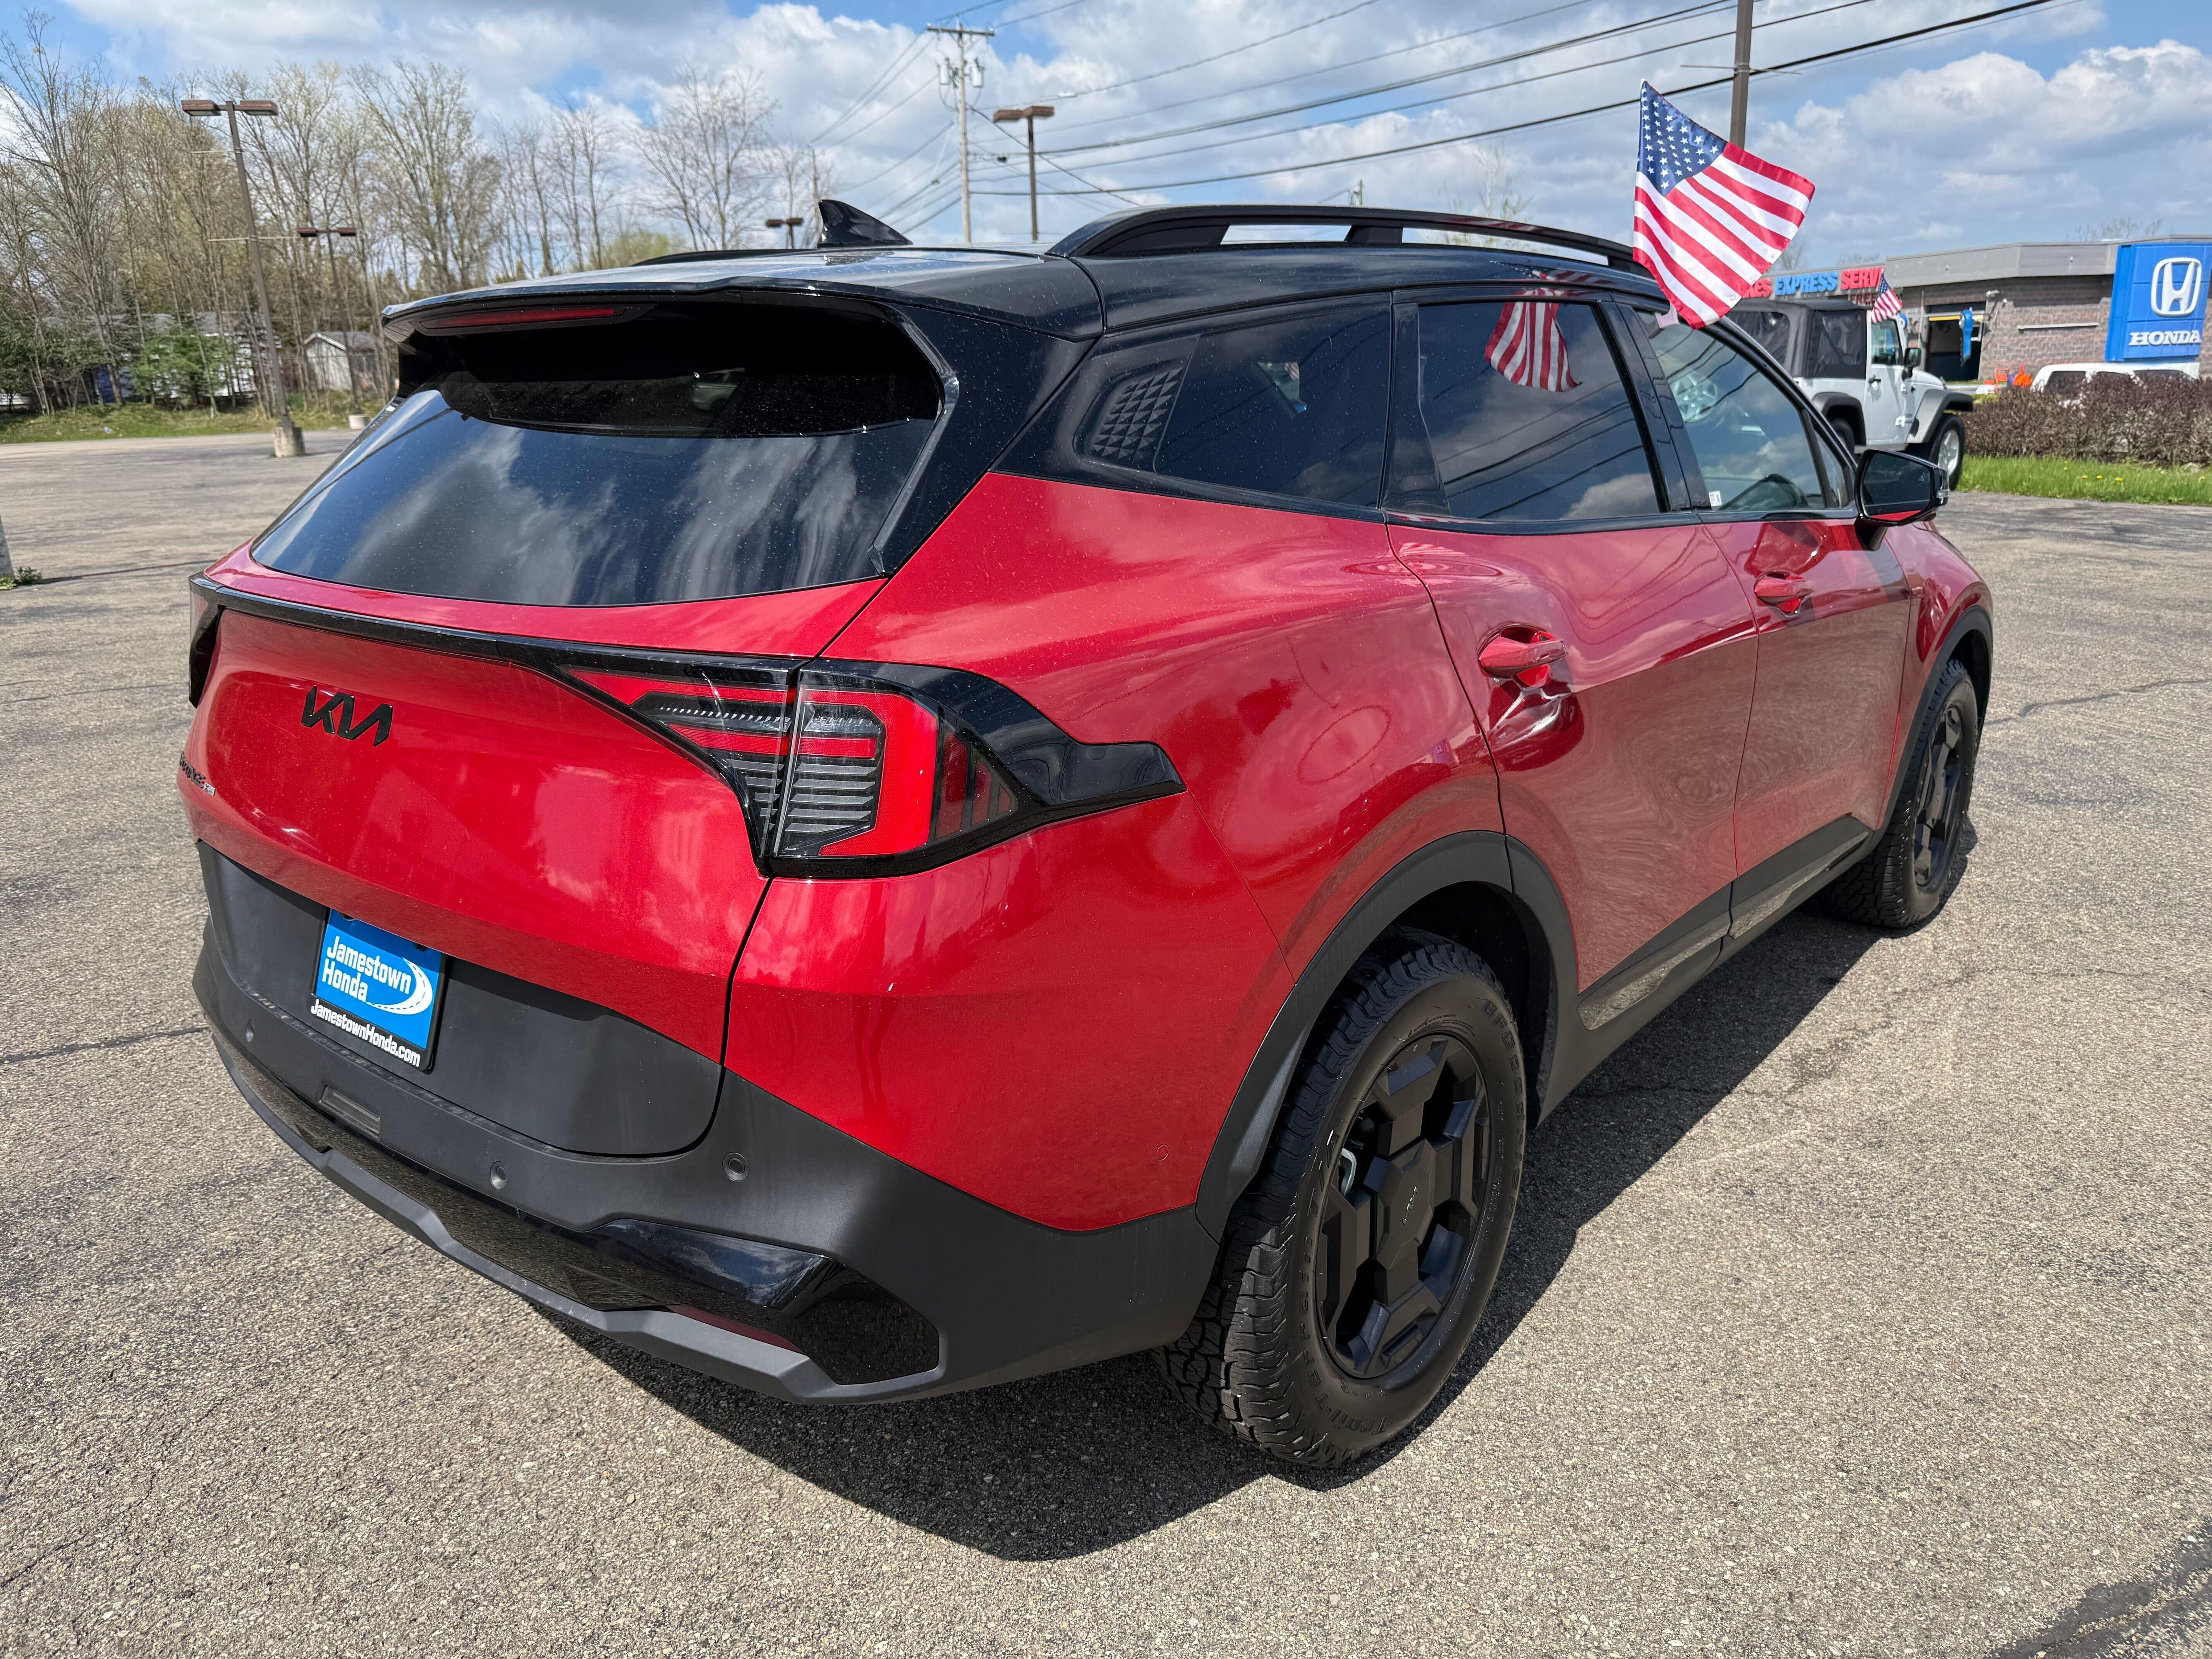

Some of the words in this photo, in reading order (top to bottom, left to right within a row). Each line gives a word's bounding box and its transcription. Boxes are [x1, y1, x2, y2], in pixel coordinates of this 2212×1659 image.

[1774, 271, 1838, 295] EXPRESS
[2128, 330, 2202, 345] HONDA
[301, 685, 393, 747] KIA
[322, 958, 368, 1003] Honda
[326, 936, 411, 994] Jamestown
[311, 999, 421, 1067] JamestownHonda.com
